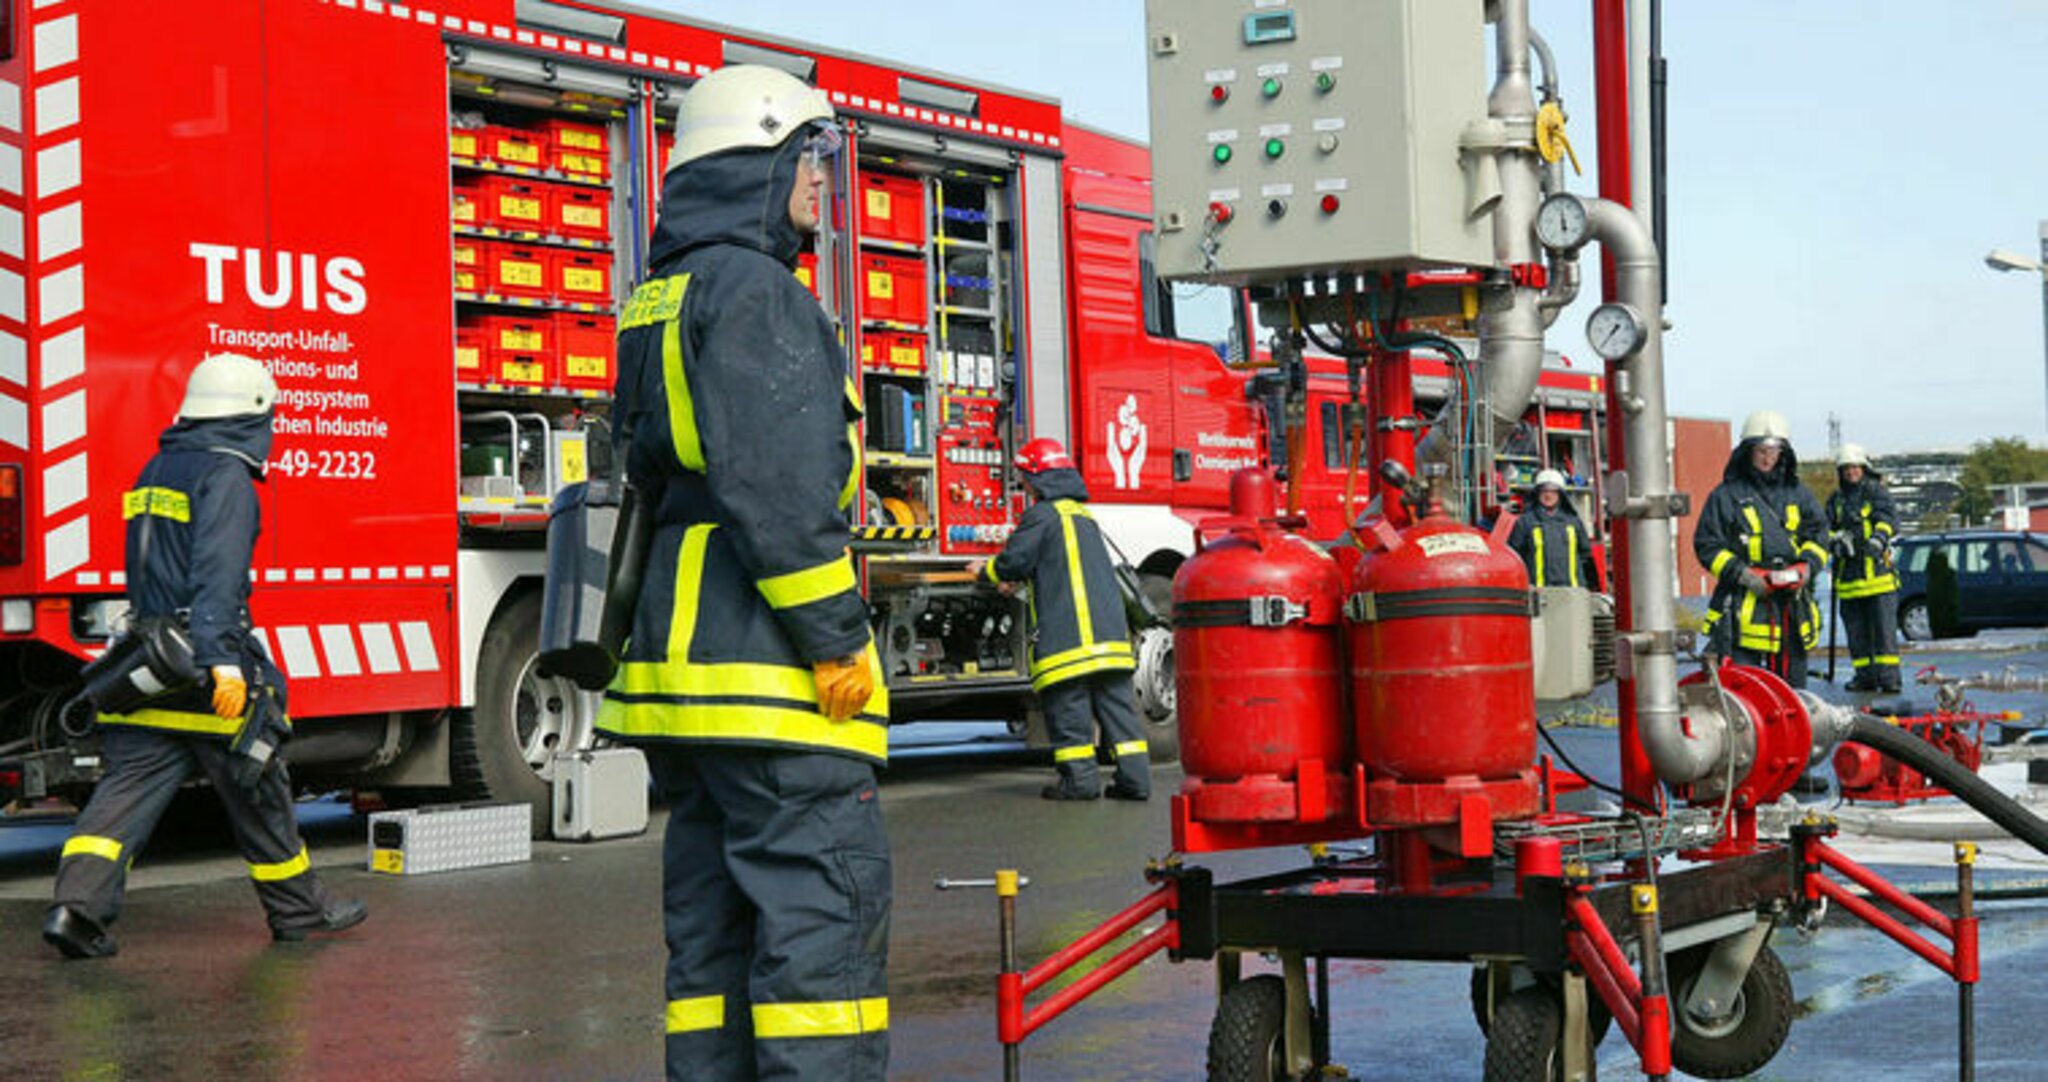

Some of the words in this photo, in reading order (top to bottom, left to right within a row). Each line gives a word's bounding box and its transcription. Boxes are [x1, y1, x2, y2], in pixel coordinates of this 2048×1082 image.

[189, 242, 368, 315] TUIS
[207, 323, 354, 352] Transport-Unfall-
[325, 360, 359, 381] und
[274, 389, 370, 411] ungssystem
[270, 413, 312, 435] chen
[315, 416, 388, 438] Industrie
[261, 449, 377, 479] -49-2232
